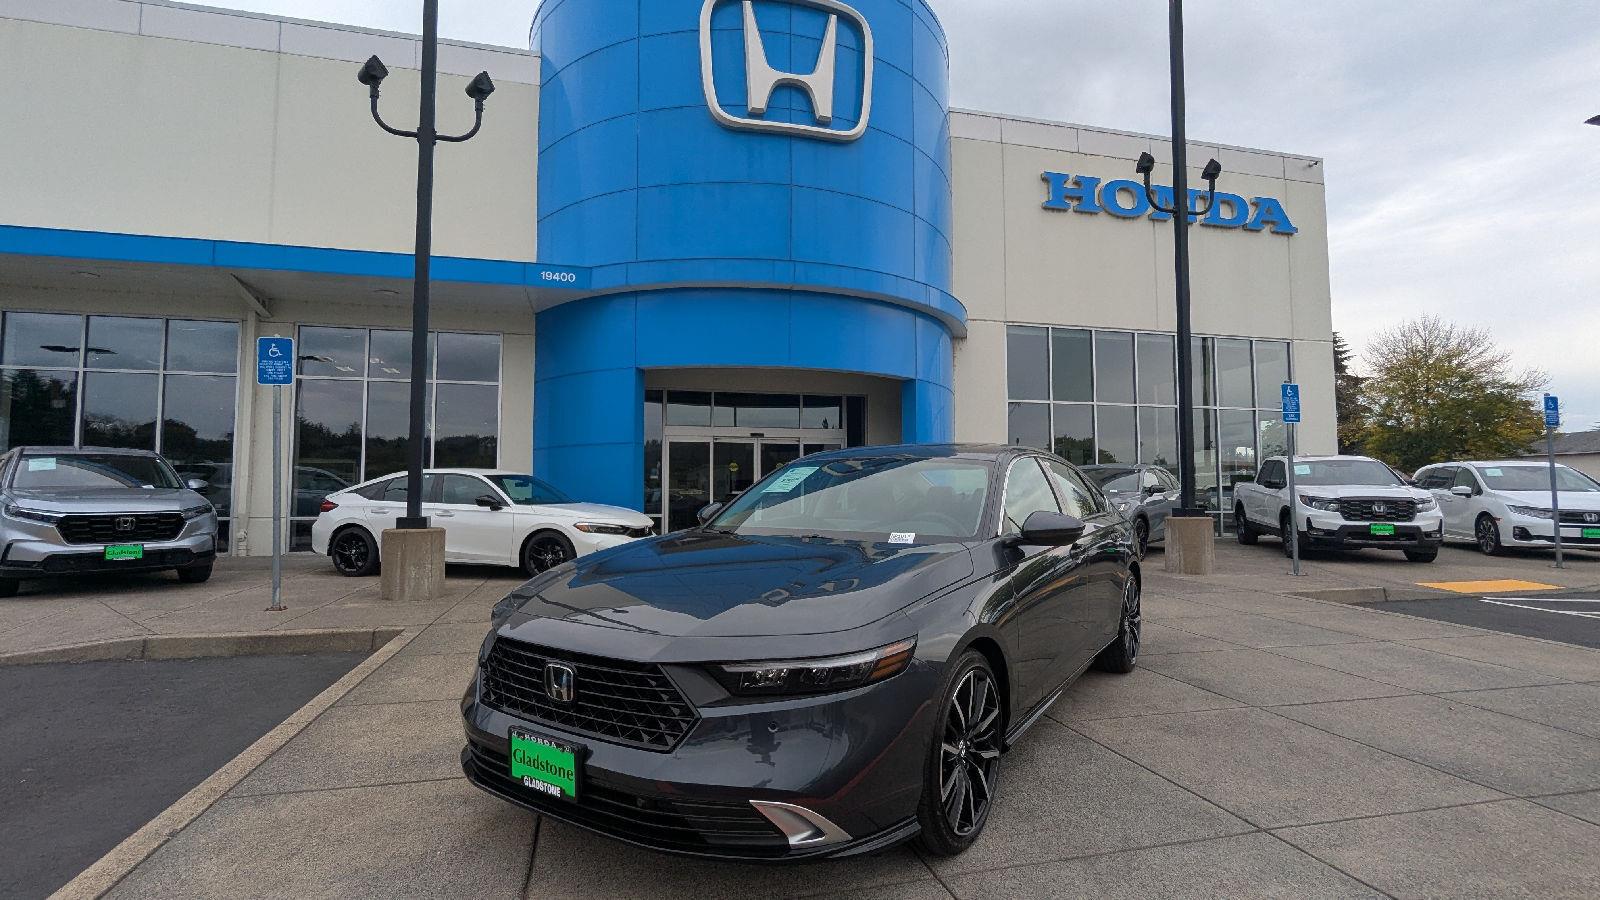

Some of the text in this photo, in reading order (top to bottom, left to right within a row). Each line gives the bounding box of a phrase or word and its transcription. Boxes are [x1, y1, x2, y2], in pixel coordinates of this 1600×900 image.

[1041, 171, 1298, 236] HONDA
[540, 271, 576, 282] 19400
[512, 748, 574, 781] Gladstone
[523, 775, 561, 798] GLADSTONE
